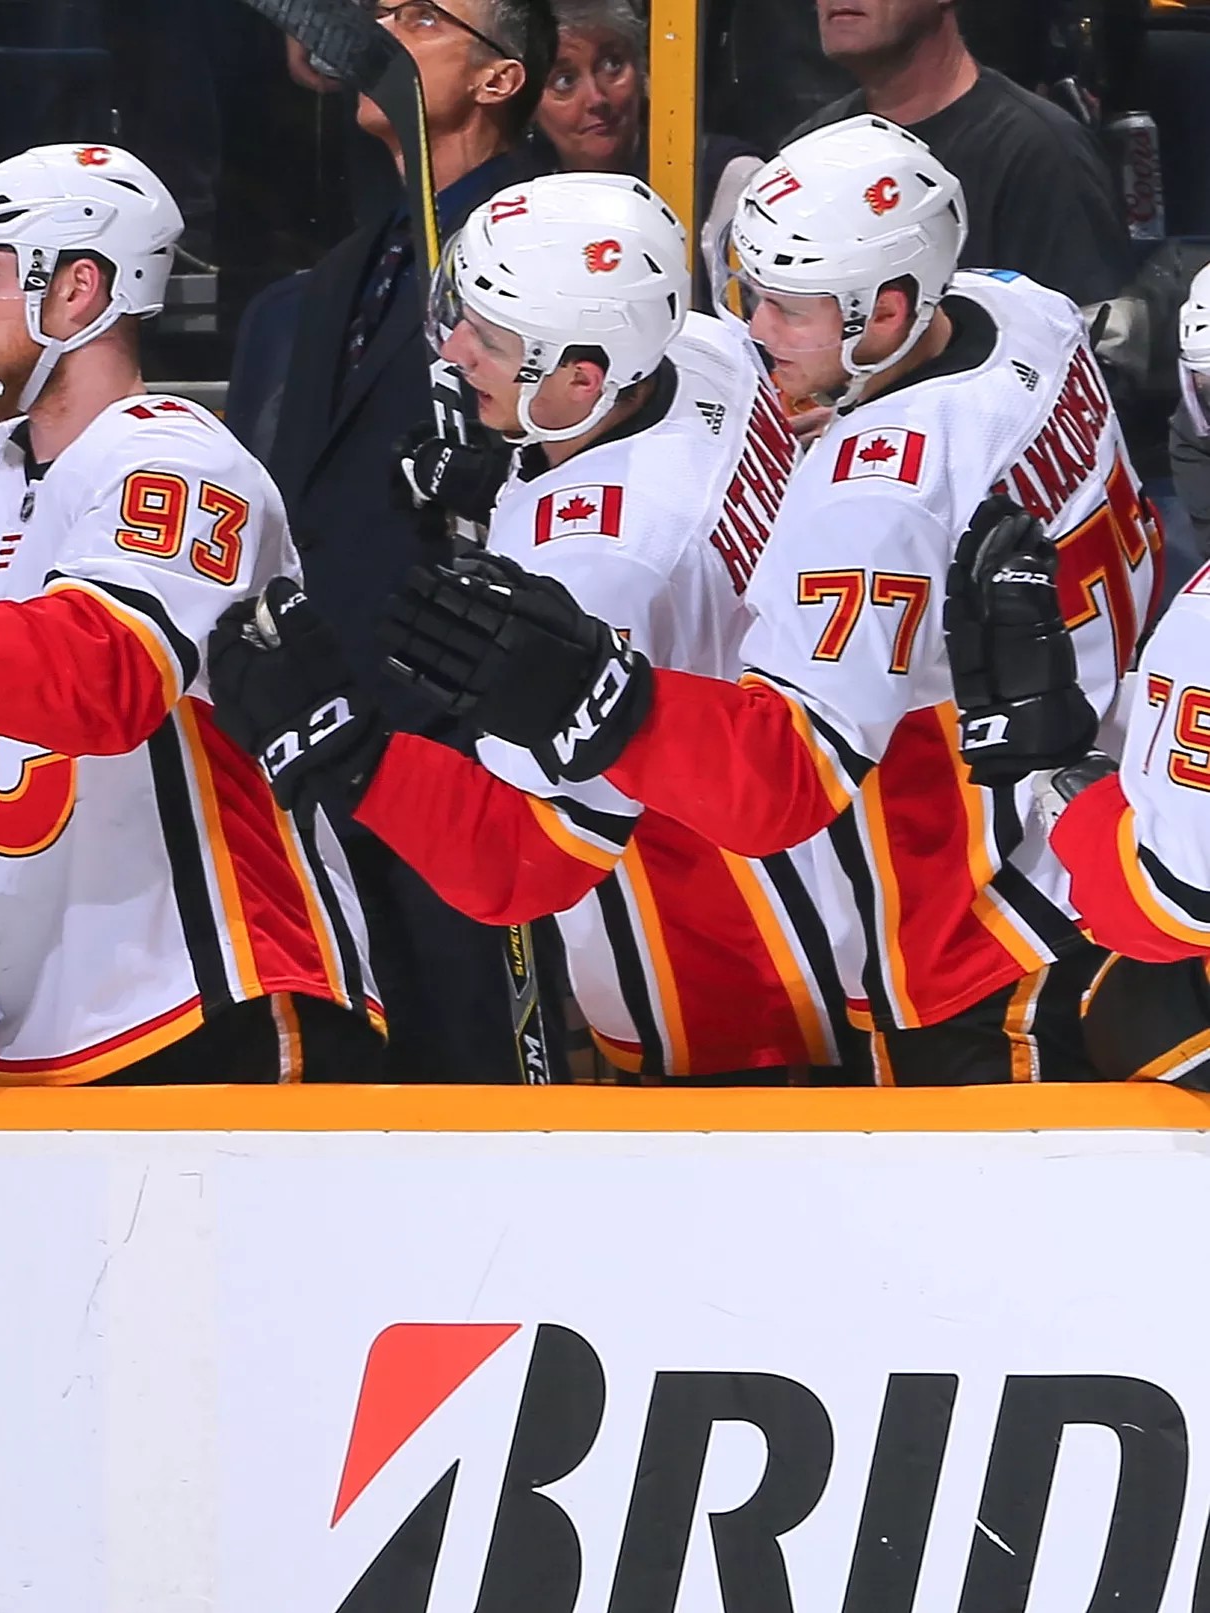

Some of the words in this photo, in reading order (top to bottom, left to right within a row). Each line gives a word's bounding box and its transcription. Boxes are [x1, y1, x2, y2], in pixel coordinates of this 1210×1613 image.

[491, 195, 528, 224] 21
[757, 166, 803, 205] 77
[115, 469, 250, 587] 93
[709, 375, 797, 597] HATHAWA
[797, 567, 932, 675] 77
[257, 696, 356, 784] CC
[552, 627, 632, 767] CM
[331, 1321, 1210, 1613] BRID
